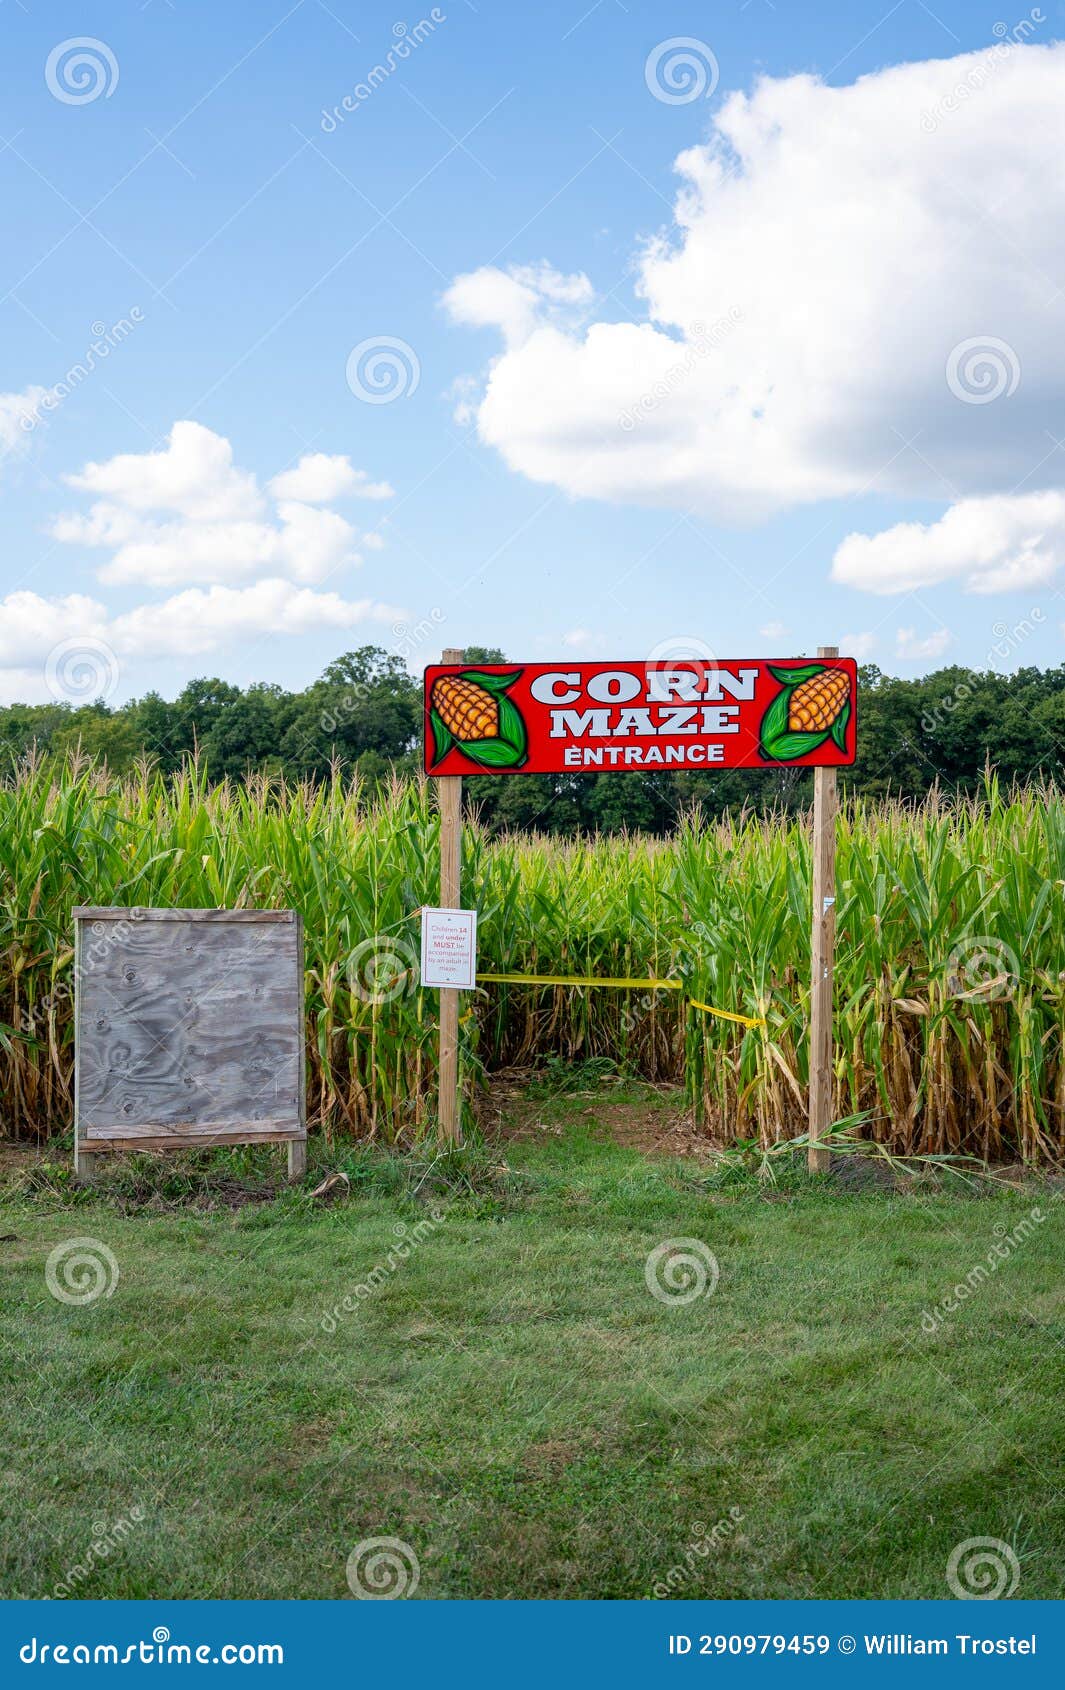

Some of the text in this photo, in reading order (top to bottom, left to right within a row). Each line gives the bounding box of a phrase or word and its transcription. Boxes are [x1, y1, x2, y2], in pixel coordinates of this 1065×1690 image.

[530, 669, 759, 705] CORN
[549, 705, 740, 738] MAZE
[564, 744, 725, 766] ENTRANCE
[431, 925, 467, 934] Children 14
